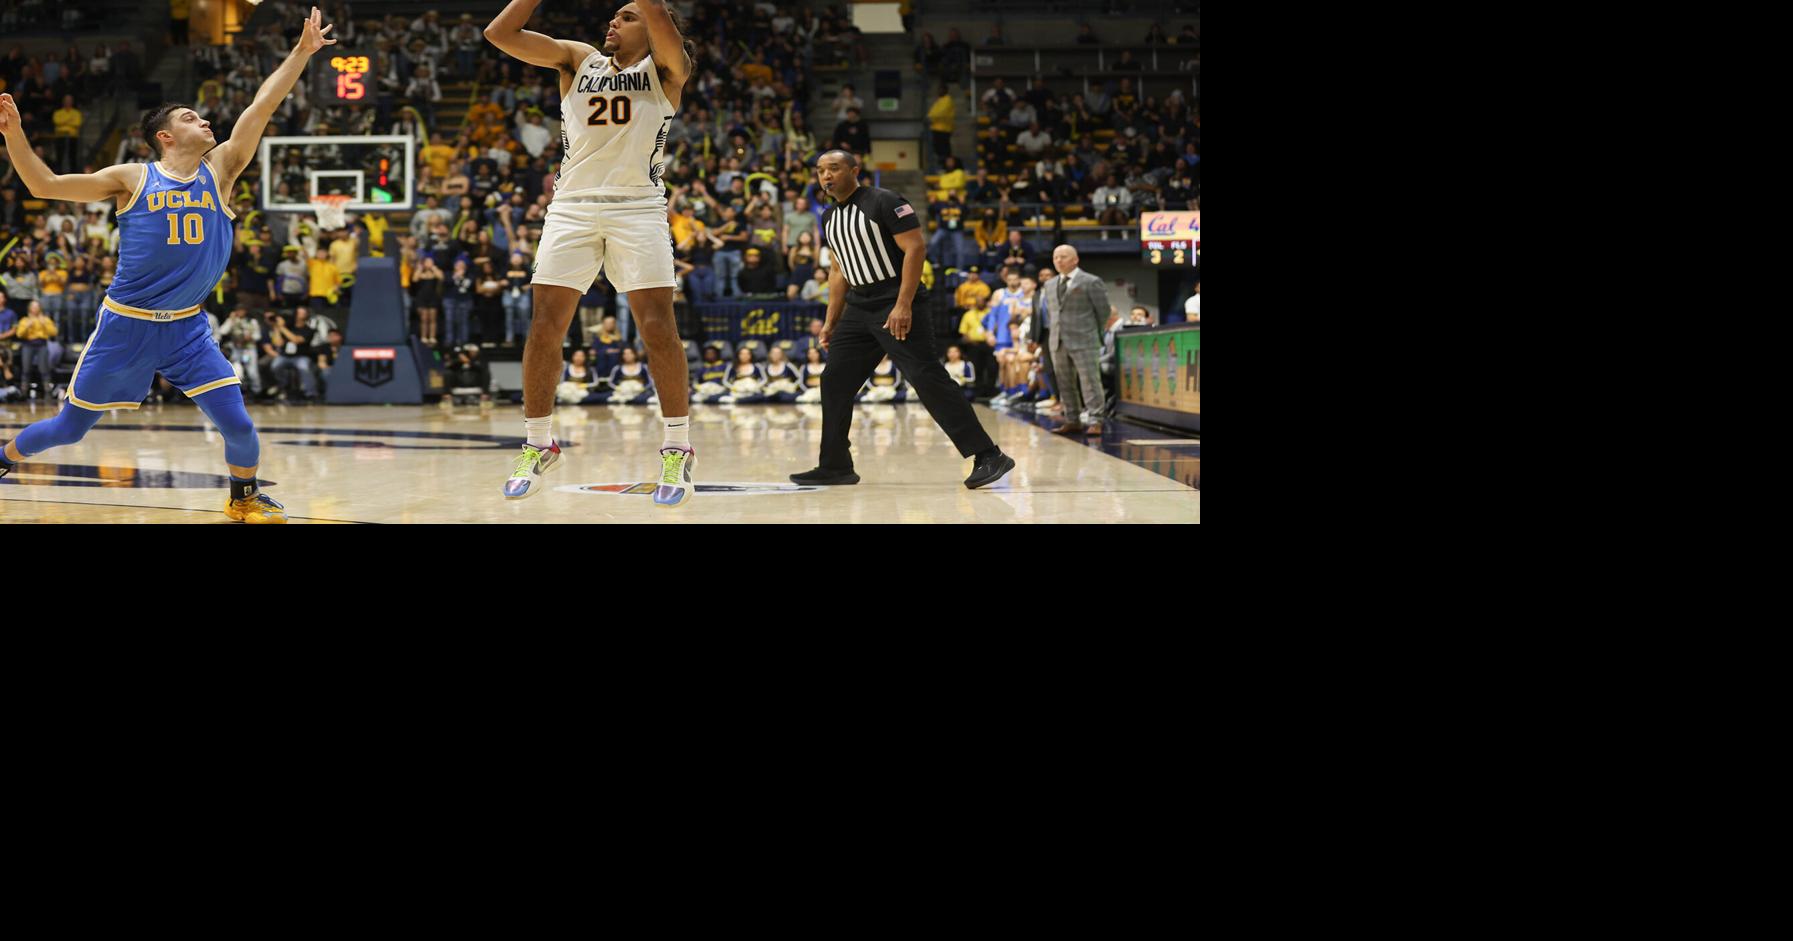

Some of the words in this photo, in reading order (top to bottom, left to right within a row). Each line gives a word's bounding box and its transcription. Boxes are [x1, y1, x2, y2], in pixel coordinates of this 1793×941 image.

[336, 73, 365, 99] 15
[577, 71, 651, 93] CALIFORNIA
[587, 95, 631, 126] 20
[146, 190, 216, 212] UCLA
[166, 213, 205, 245] 10
[1147, 213, 1178, 236] Cal
[1150, 249, 1161, 264] 3
[1173, 249, 1184, 264] 2
[741, 308, 780, 336] Cal
[1185, 349, 1200, 392] H
